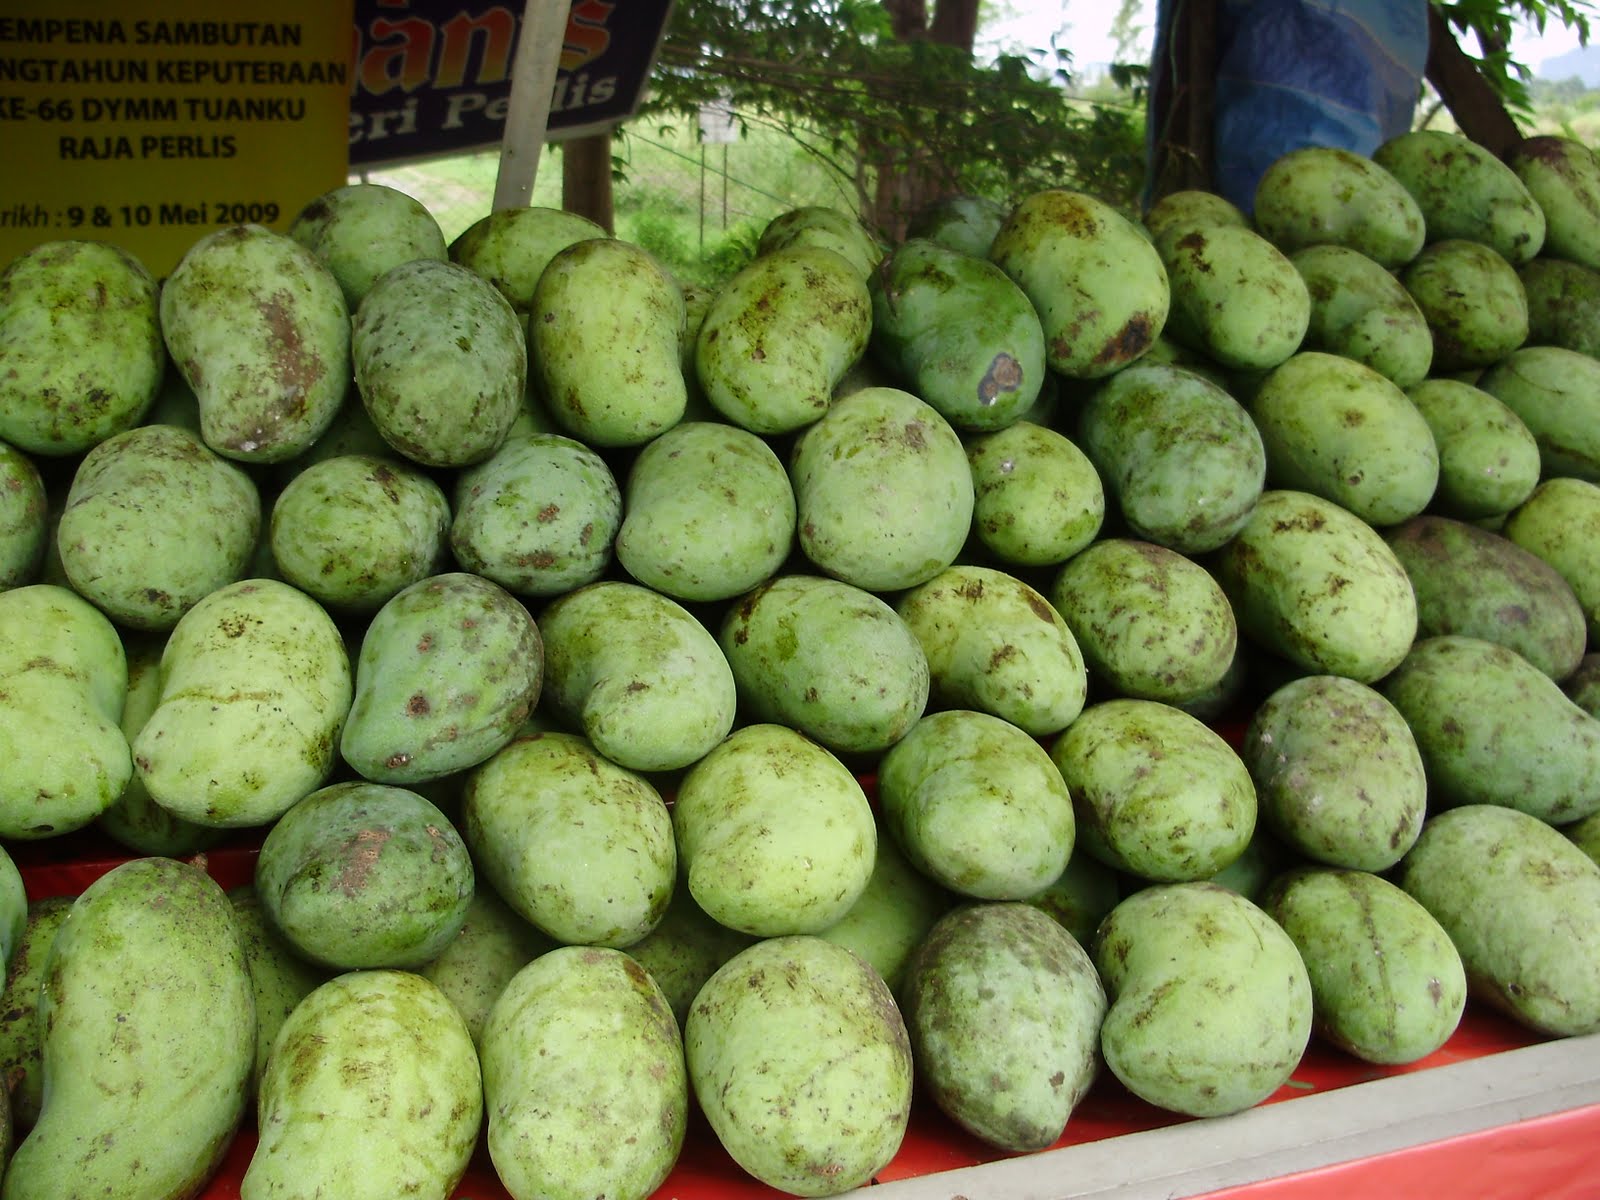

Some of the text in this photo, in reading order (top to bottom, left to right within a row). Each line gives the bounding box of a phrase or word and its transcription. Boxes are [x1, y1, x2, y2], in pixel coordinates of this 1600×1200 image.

[0, 18, 302, 47] EMPENA SAMBUTAN
[0, 58, 346, 85] NGTAHUN KEPUTERAAN
[82, 98, 178, 122] DYMM
[184, 97, 306, 121] TUANKU
[441, 75, 617, 130] Pelis
[60, 136, 237, 160] RAJA PERLIS
[68, 206, 84, 227] 9
[91, 206, 112, 227] &
[121, 206, 151, 227] 10
[160, 204, 207, 226] Mei
[215, 203, 280, 225] 2009
